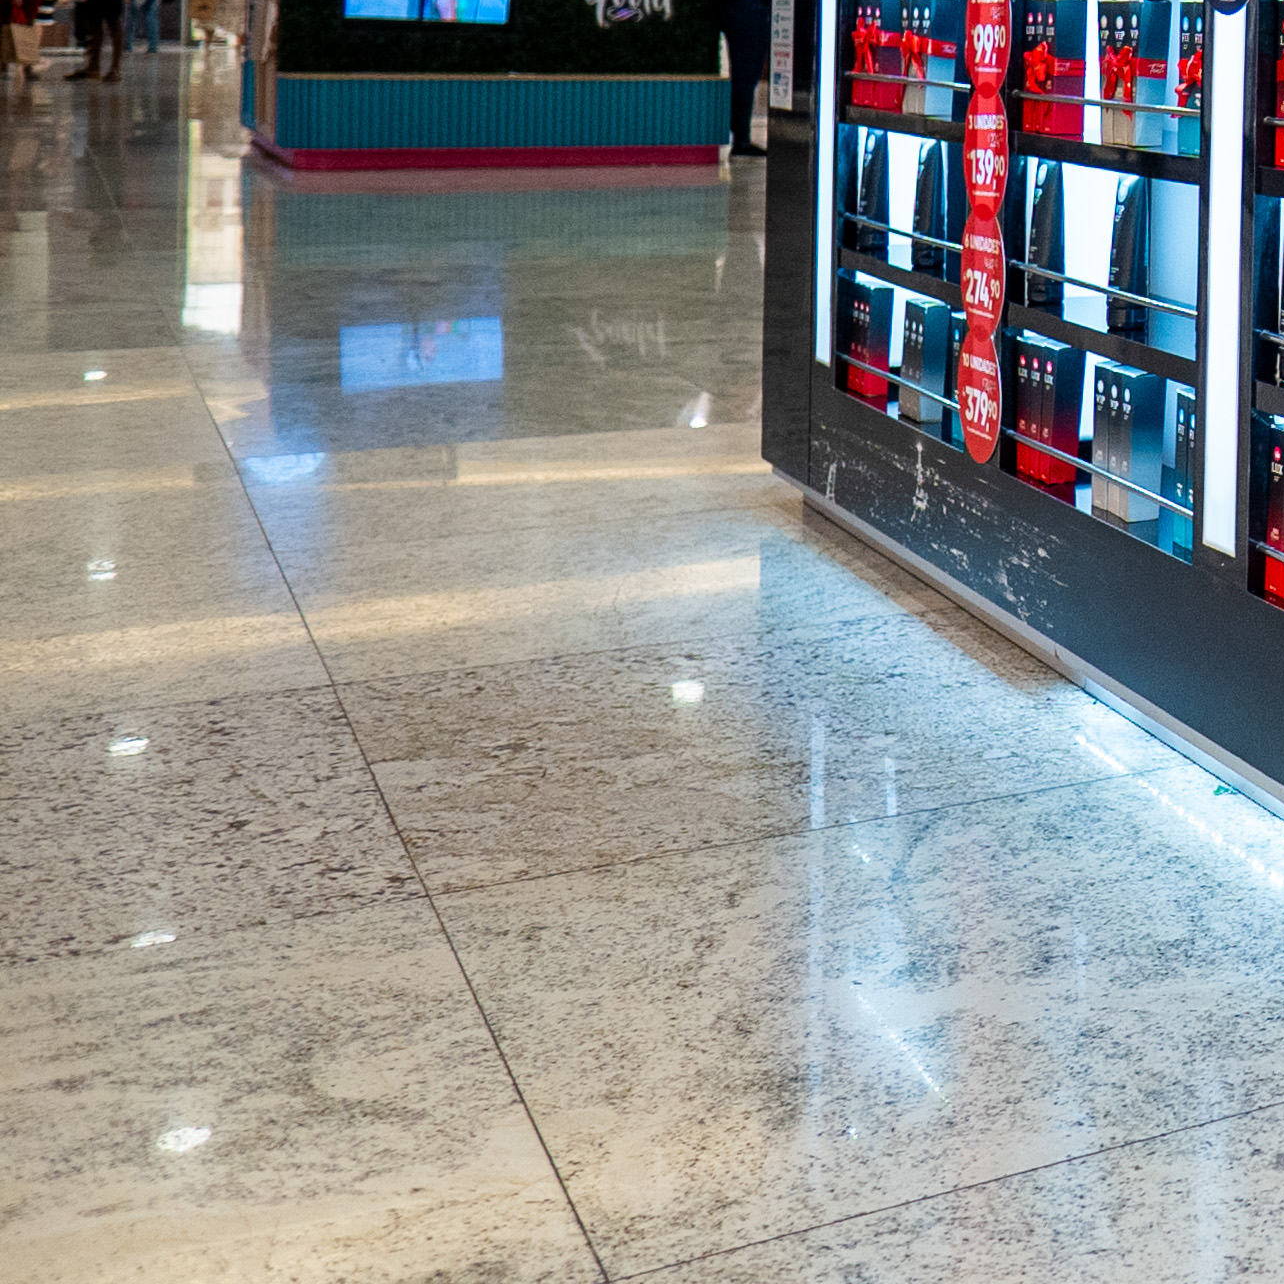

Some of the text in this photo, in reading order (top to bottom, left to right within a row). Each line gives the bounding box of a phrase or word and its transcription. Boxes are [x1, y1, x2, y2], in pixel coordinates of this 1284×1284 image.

[968, 114, 973, 130] 3
[964, 234, 969, 248] 6
[962, 353, 970, 367] 10
